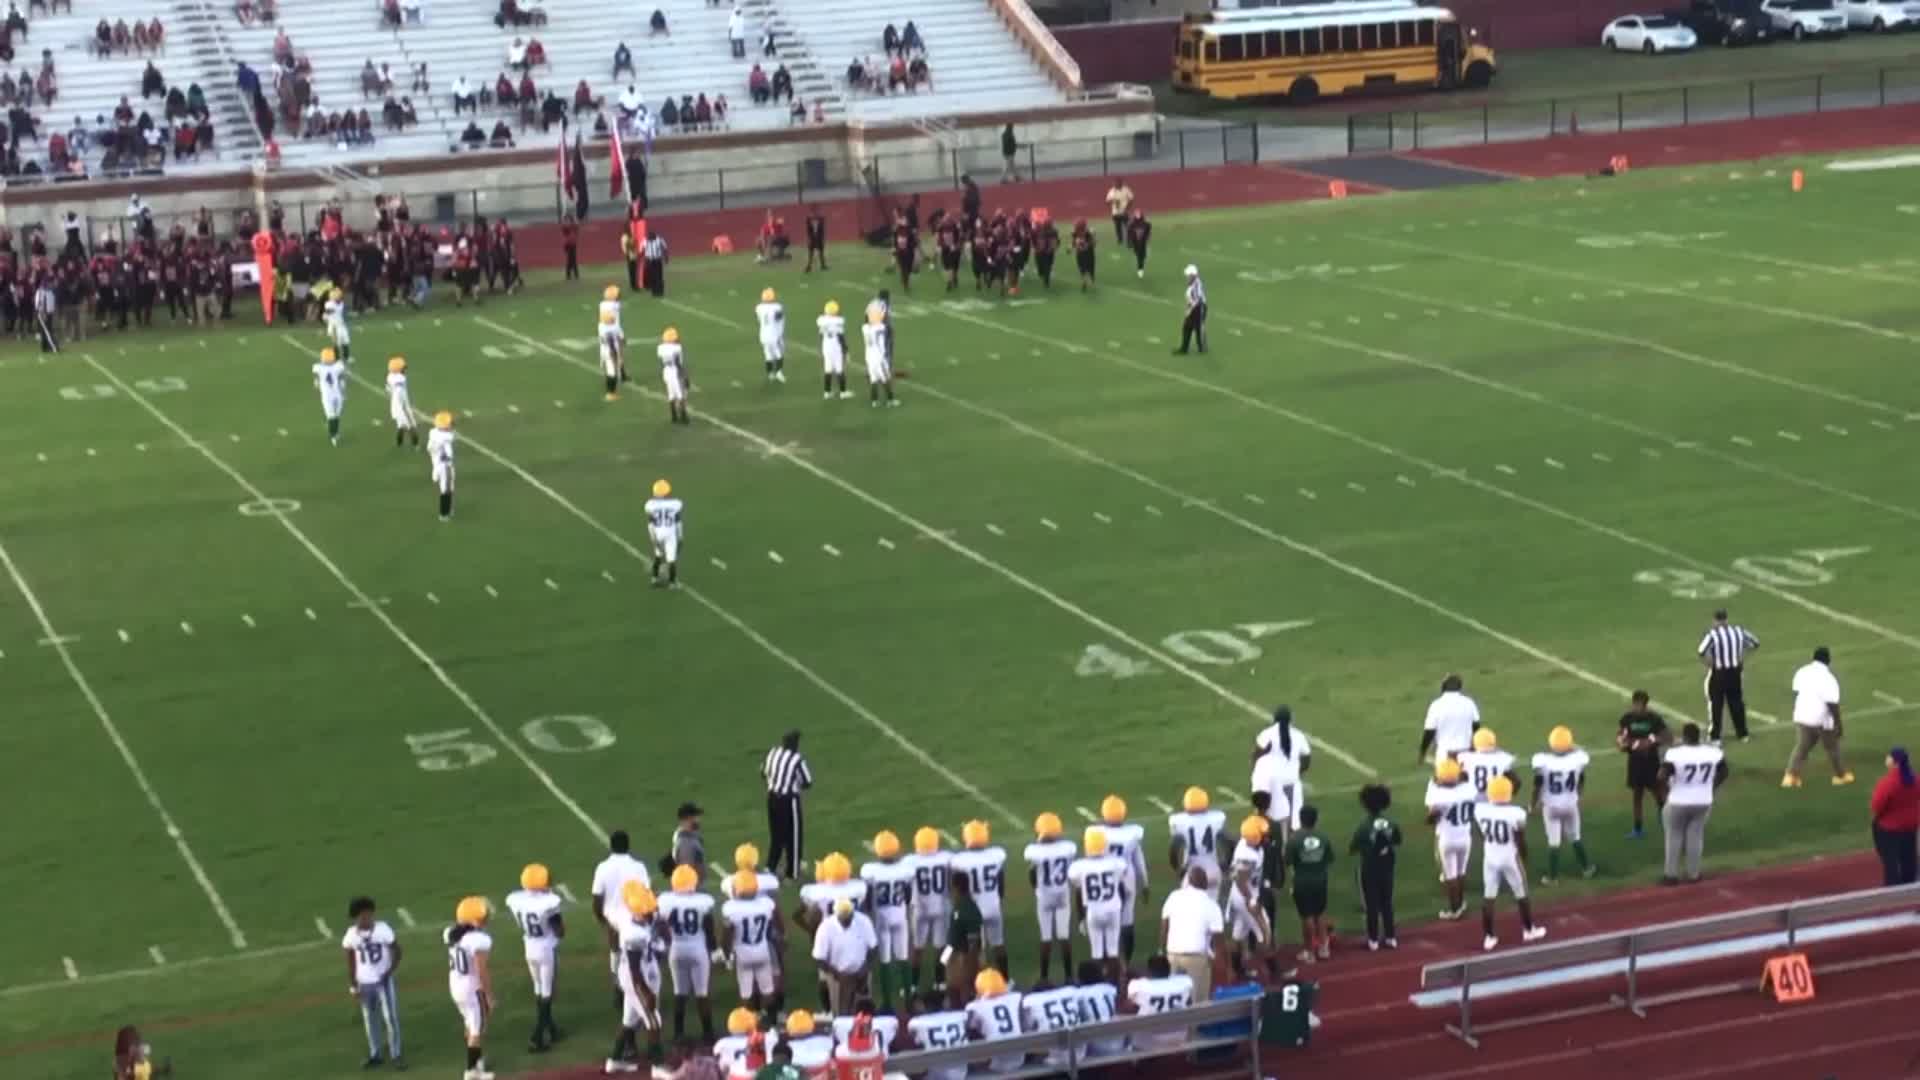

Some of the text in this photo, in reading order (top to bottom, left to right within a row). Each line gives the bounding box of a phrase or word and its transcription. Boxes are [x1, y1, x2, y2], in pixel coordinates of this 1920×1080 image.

[1684, 763, 1713, 785] 77
[1188, 825, 1214, 856] 14
[916, 865, 945, 896] 60
[971, 864, 997, 894] 15
[1043, 858, 1069, 888] 13
[1086, 871, 1116, 901] 65
[741, 914, 767, 945] 17
[1778, 959, 1809, 994] 40
[1282, 984, 1300, 1012] 6
[993, 1004, 1013, 1034] 9
[1043, 997, 1079, 1030] 55
[927, 1023, 961, 1048] 52
